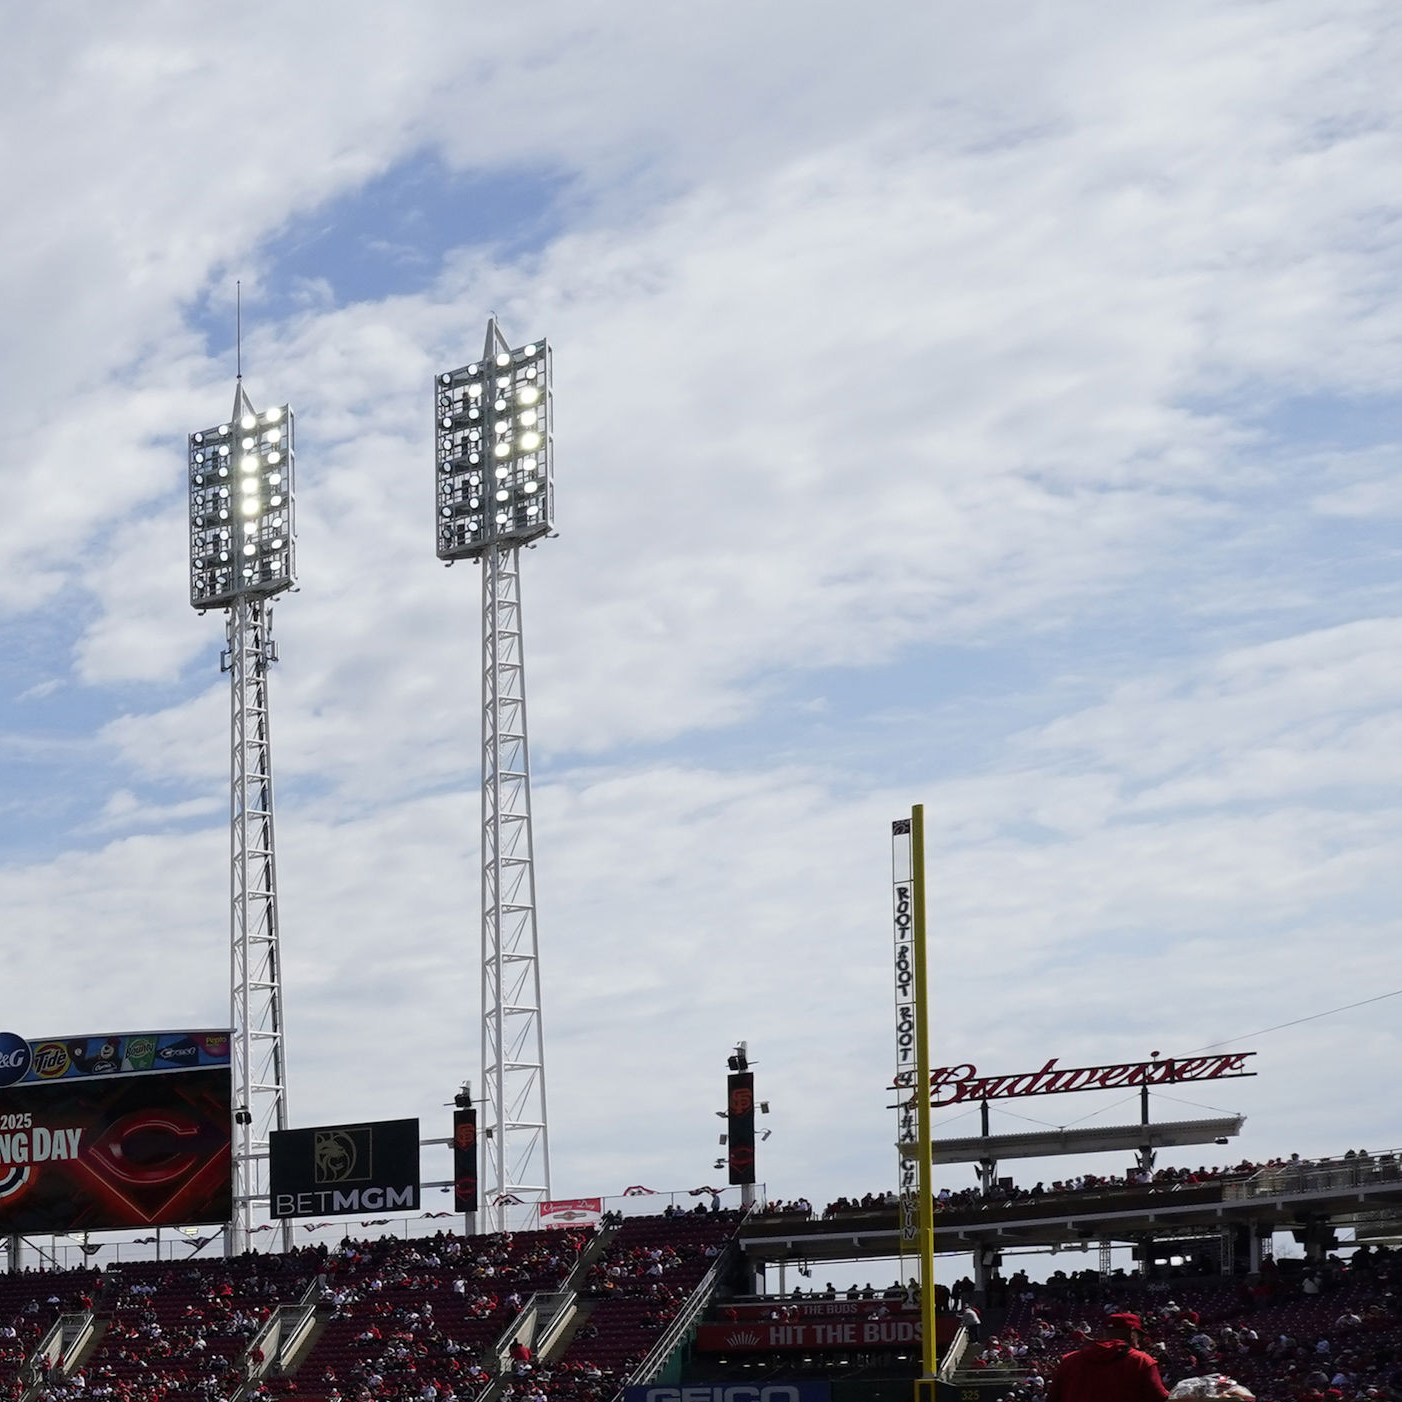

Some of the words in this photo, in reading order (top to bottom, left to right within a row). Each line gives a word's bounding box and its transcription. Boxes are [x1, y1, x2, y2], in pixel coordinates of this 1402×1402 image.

[895, 887, 911, 940] ROOT
[896, 946, 912, 997] ROOT
[897, 1007, 914, 1061] ROOT
[35, 1048, 66, 1072] Tide
[894, 1051, 1249, 1110] Budweiser
[0, 1113, 32, 1130] 2025
[32, 1128, 82, 1162] DAY
[276, 1185, 413, 1216] BETMGM
[804, 1306, 824, 1314] THE
[826, 1304, 858, 1314] BUDS
[770, 1325, 807, 1346] HIT
[812, 1325, 856, 1345] THE
[864, 1322, 925, 1344] BUDS
[961, 1389, 980, 1400] 325
